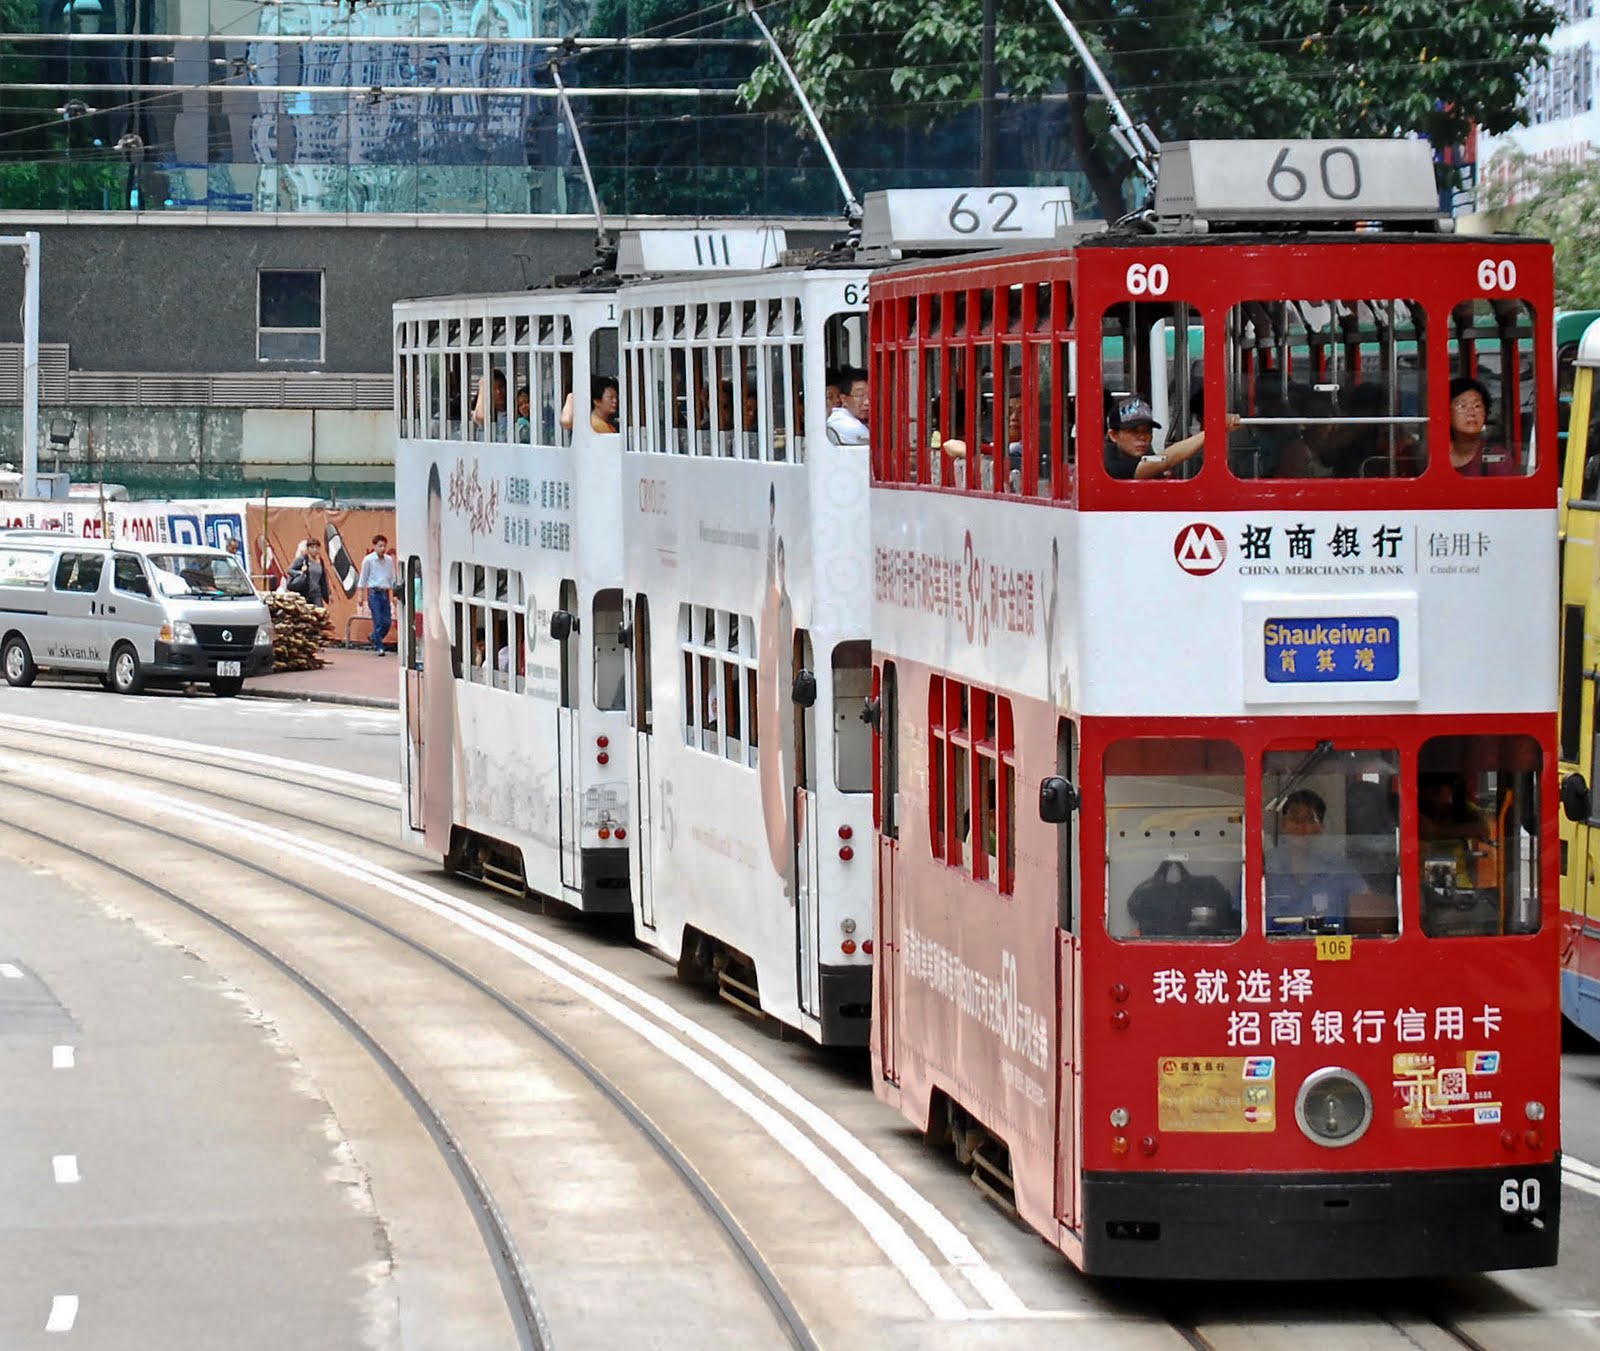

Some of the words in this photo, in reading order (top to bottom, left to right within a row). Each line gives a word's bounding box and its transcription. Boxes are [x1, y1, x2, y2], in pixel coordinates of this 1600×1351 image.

[1266, 146, 1362, 200] 60
[948, 191, 1023, 234] 62
[693, 233, 730, 265] 111
[1125, 262, 1169, 297] 60
[1476, 258, 1518, 292] 60
[1428, 531, 1492, 558] 信用卡
[1239, 565, 1280, 576] CHINA
[1285, 565, 1365, 576] MERCHANTS
[1370, 565, 1404, 575] BANK
[1264, 623, 1391, 646] Shaukeiwan
[1320, 940, 1347, 955] 106
[1152, 967, 1314, 1005] 我就选择
[1227, 1003, 1502, 1047] 招商银行信用卡
[1477, 1109, 1499, 1120] VISA
[1499, 1177, 1542, 1213] 60
